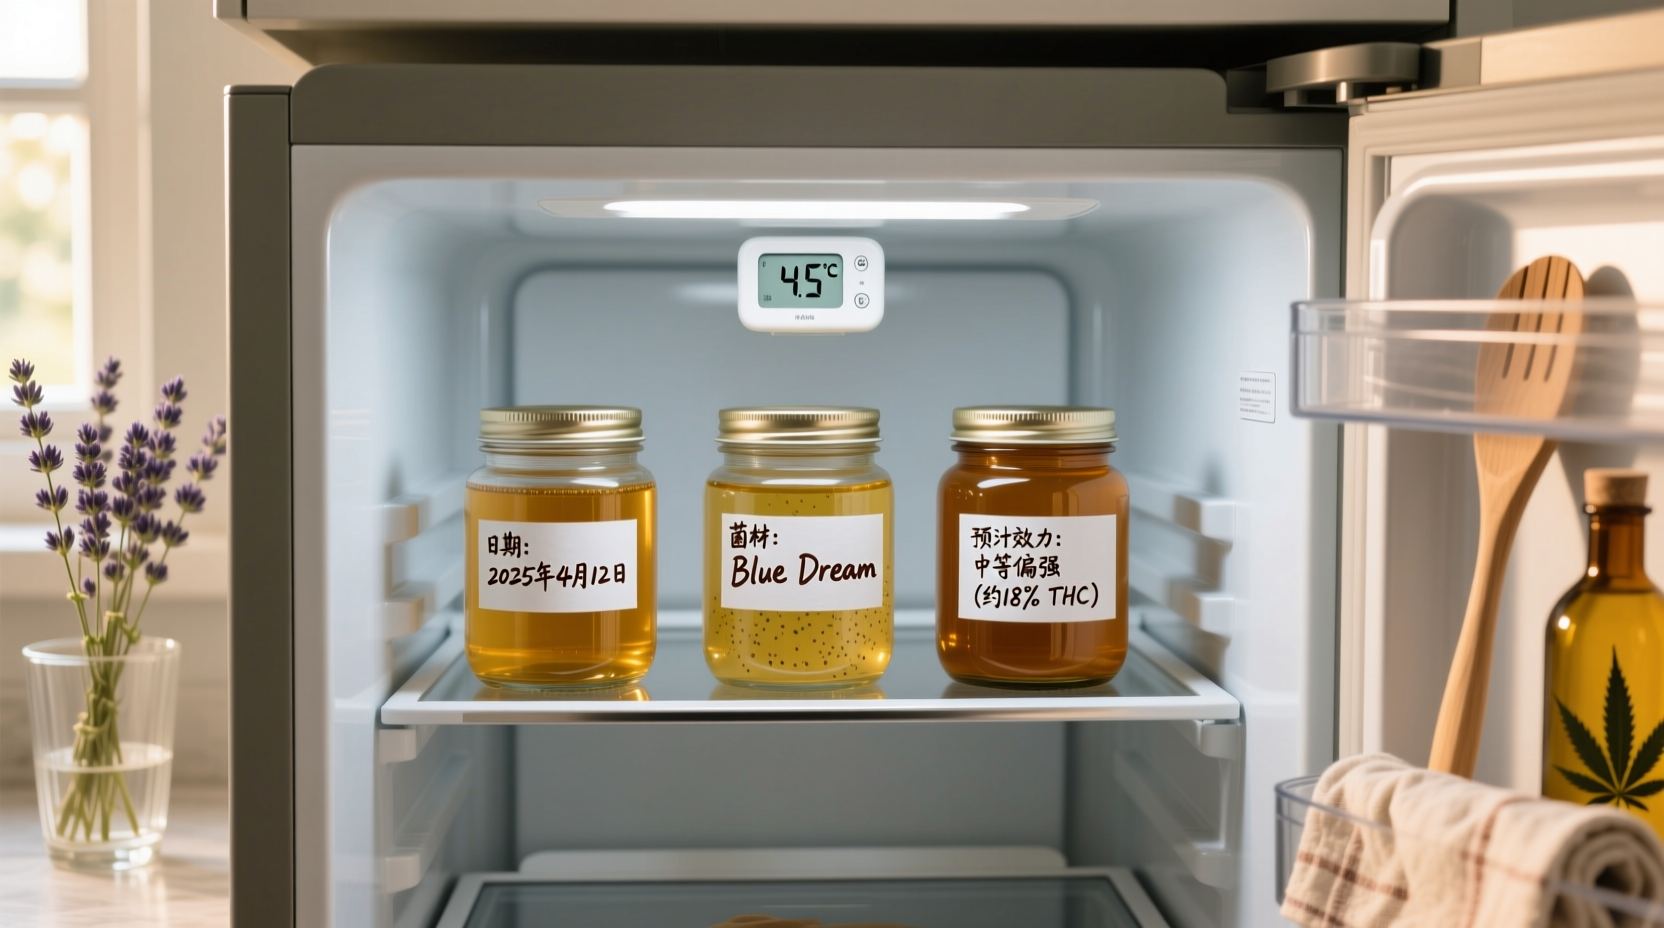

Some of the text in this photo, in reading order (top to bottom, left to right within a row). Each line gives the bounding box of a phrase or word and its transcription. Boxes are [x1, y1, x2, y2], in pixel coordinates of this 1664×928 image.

[780, 263, 838, 298] 4.5°C
[487, 561, 626, 592] 2025年4月12日
[731, 552, 877, 588] Blue Dream
[974, 553, 1060, 579] 中等偏强
[974, 581, 1099, 610] (约18% THC)
